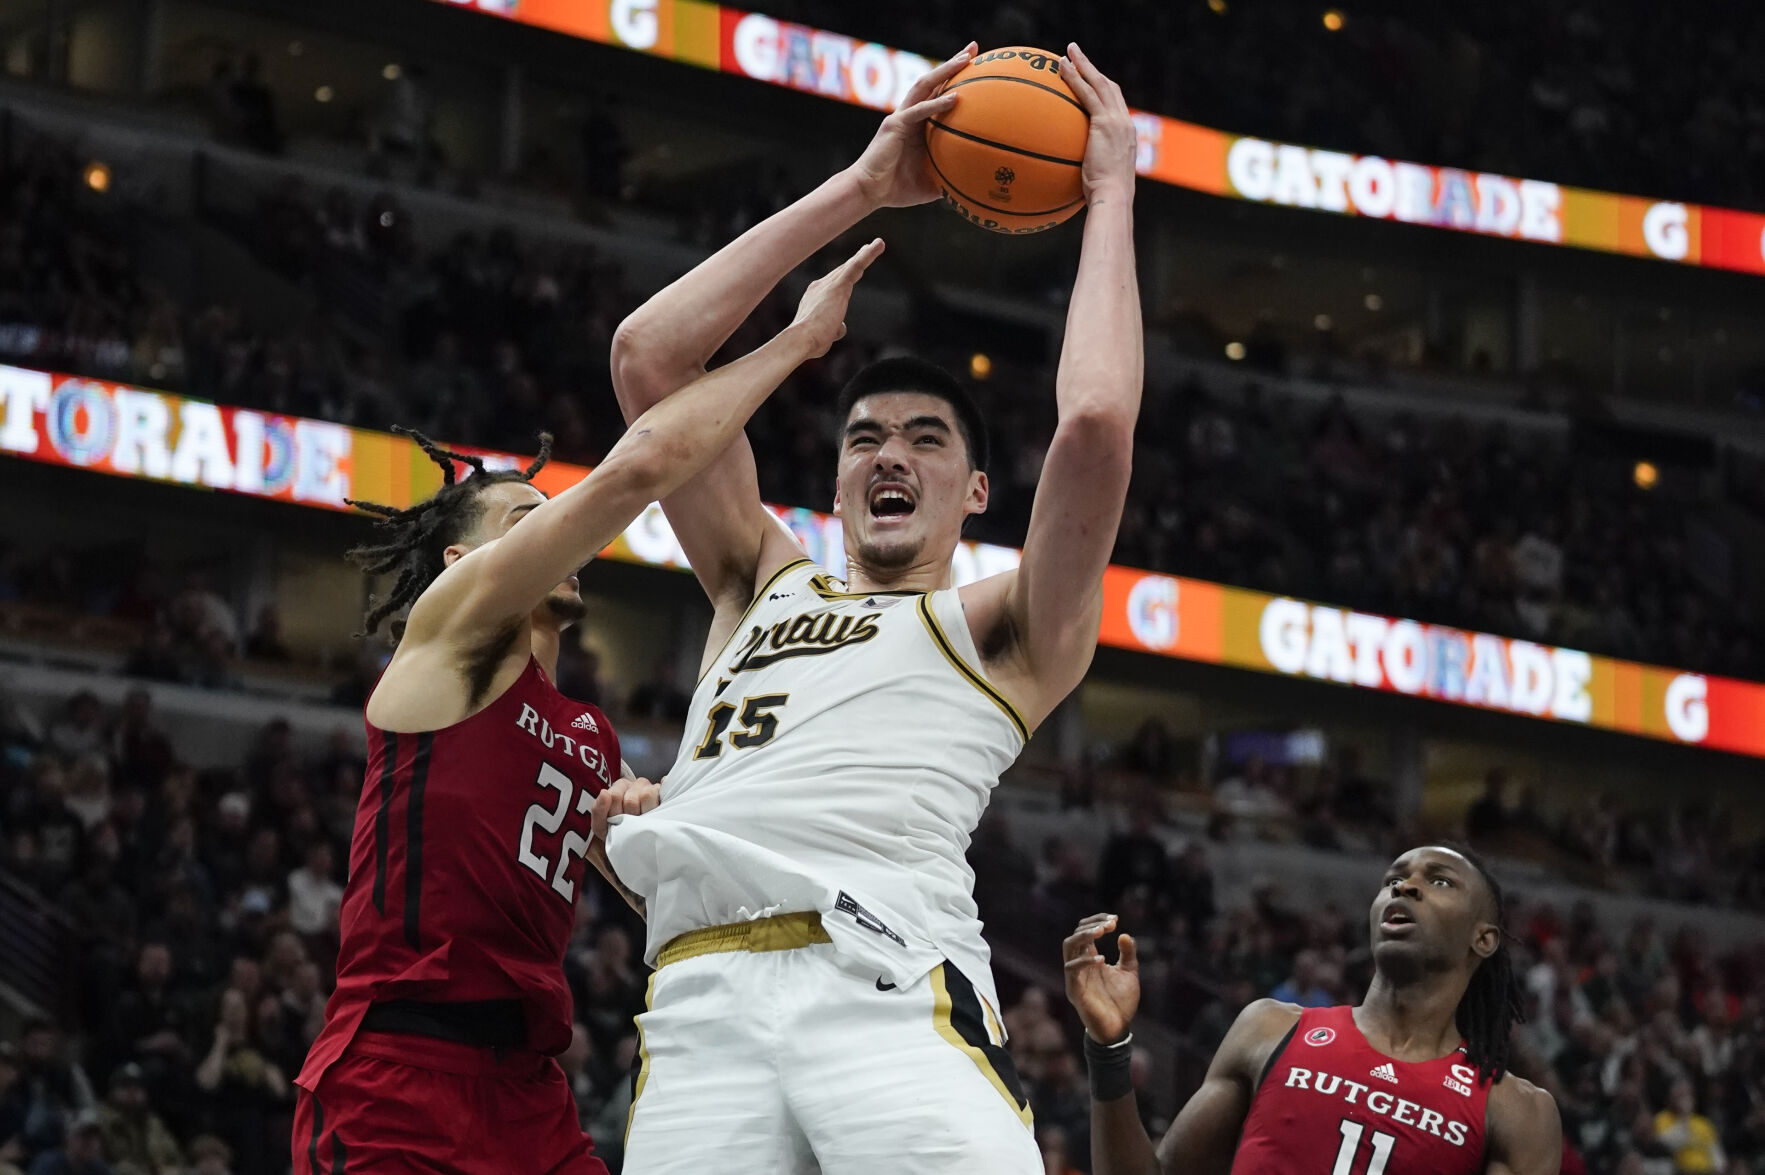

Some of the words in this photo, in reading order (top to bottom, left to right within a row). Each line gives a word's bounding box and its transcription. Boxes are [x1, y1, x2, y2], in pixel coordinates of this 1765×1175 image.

[610, 0, 658, 49] G
[733, 13, 932, 110] GATOR
[974, 50, 1061, 74] ilson
[1228, 136, 1561, 243] GATORADE
[1643, 201, 1688, 260] G
[0, 363, 349, 507] TORADE
[1127, 575, 1179, 650] G
[1259, 597, 1592, 722] GATORADE
[516, 702, 612, 787] RUTGE
[693, 690, 791, 761] 15
[1665, 673, 1709, 743] G
[518, 761, 597, 904] 22
[1285, 1067, 1468, 1146] RUTGERS
[1370, 1068, 1399, 1084] adidas
[1451, 1064, 1475, 1084] C
[1332, 1119, 1396, 1175] 11
